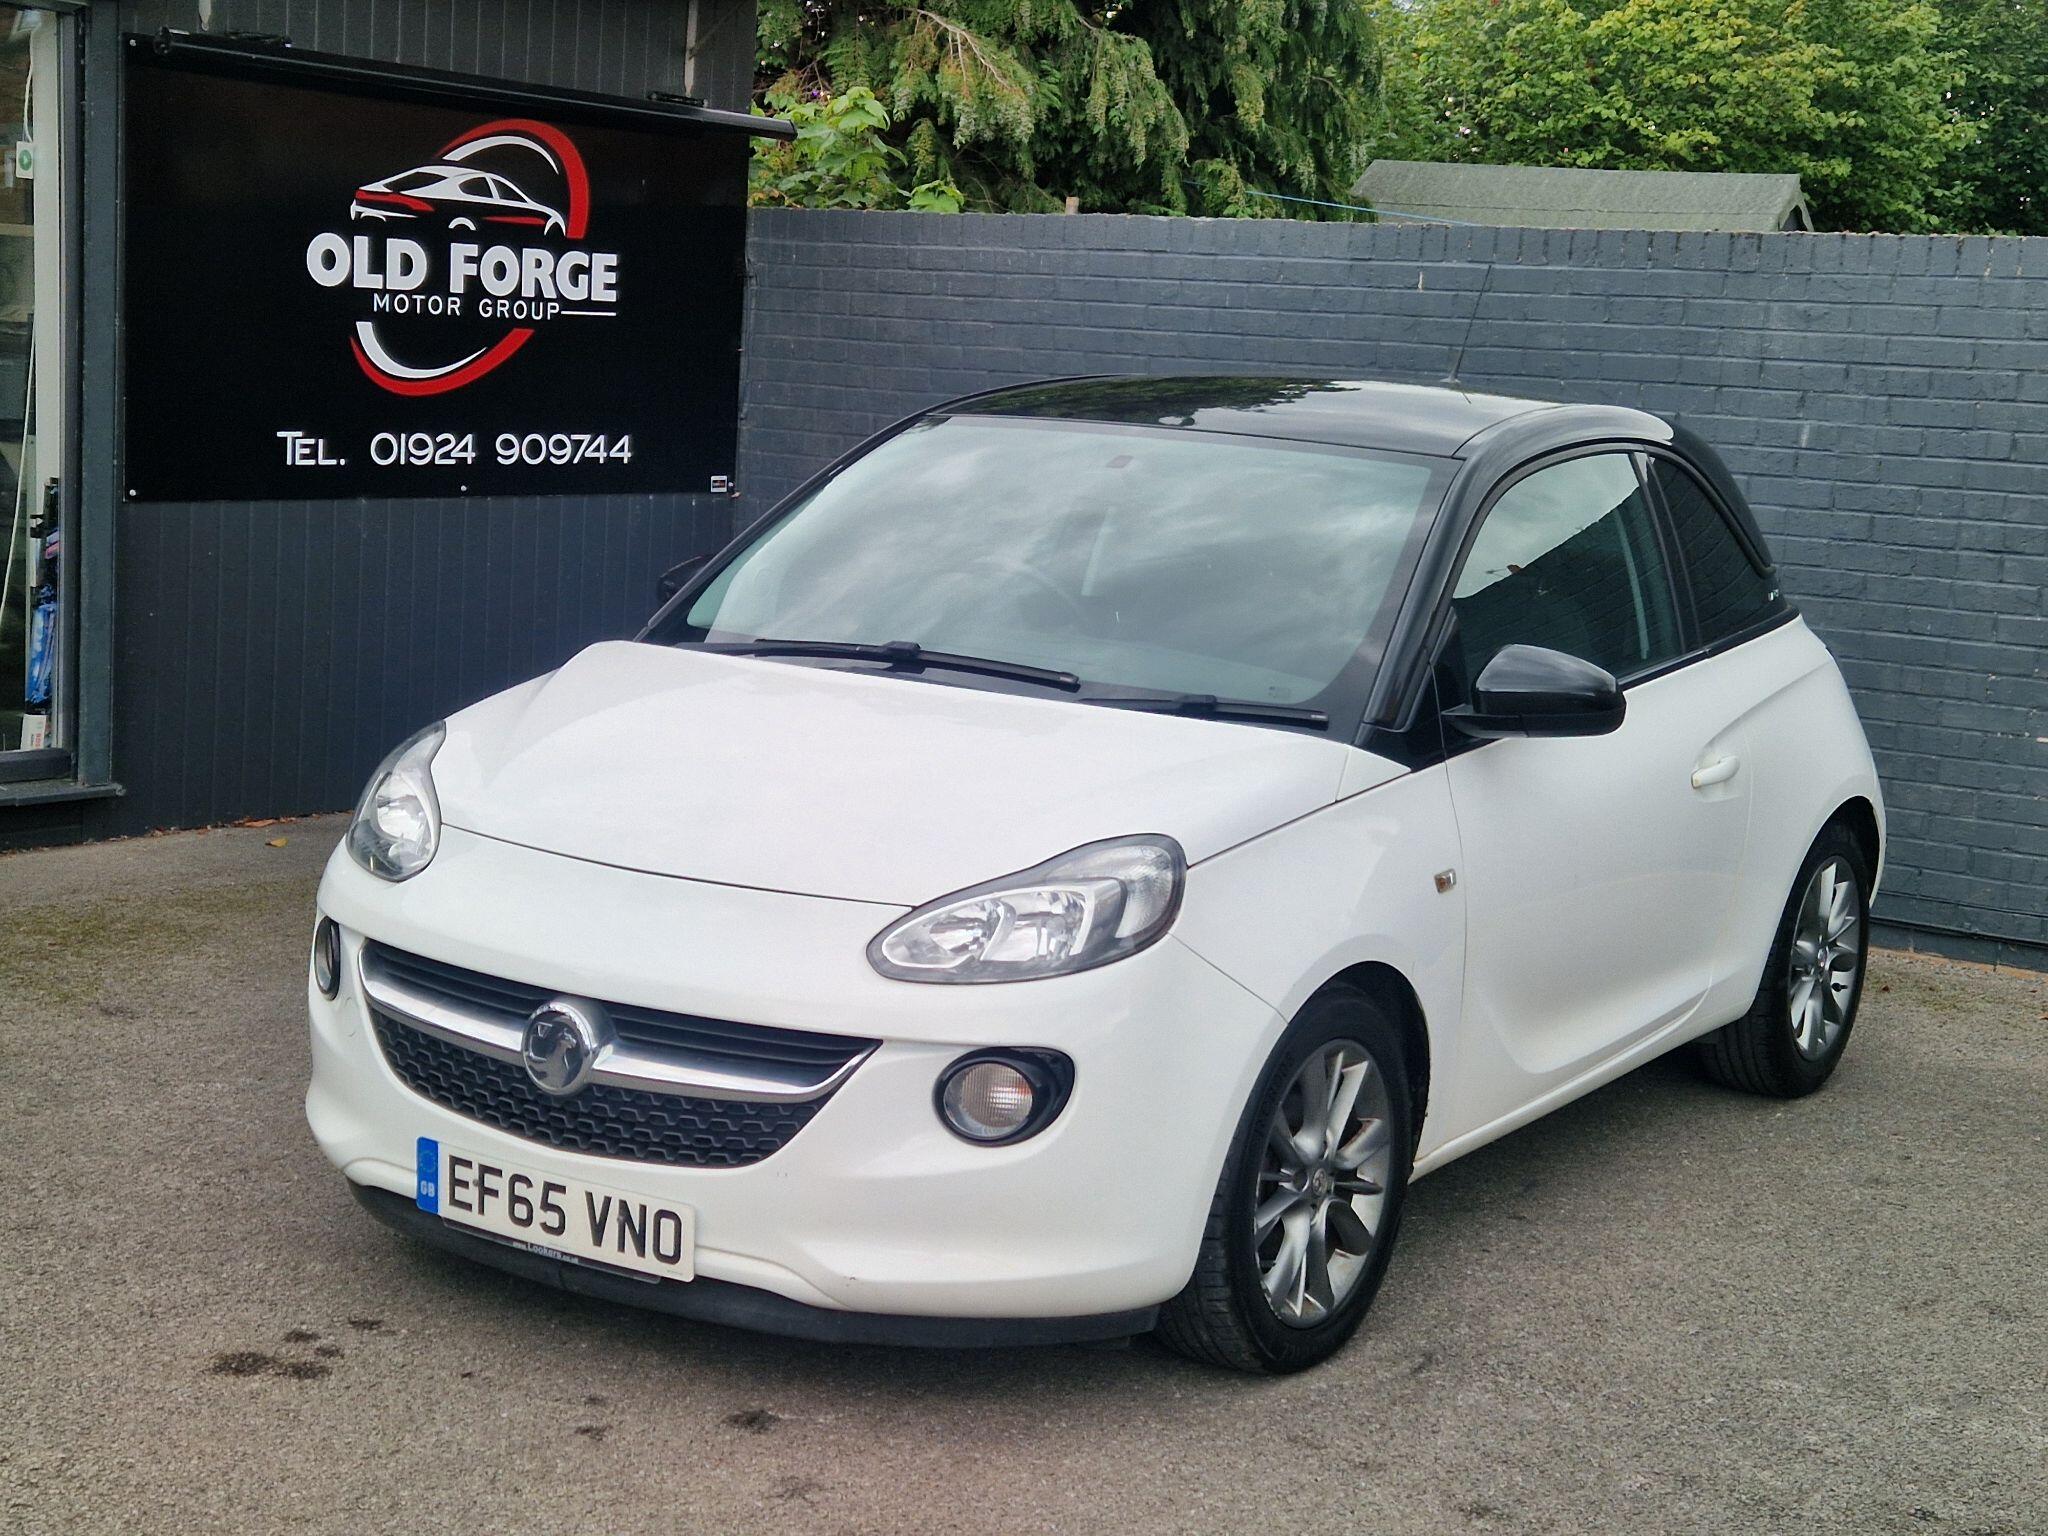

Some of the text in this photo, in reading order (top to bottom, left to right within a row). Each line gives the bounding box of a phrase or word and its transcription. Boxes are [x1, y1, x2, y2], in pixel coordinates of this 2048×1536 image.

[306, 232, 618, 302] OLD FORGE
[373, 293, 560, 321] MOTOR GROUP
[370, 432, 476, 466] 01924
[495, 432, 632, 465] 909744
[420, 1180, 436, 1198] GB
[448, 1154, 683, 1265] EF65 VNO
